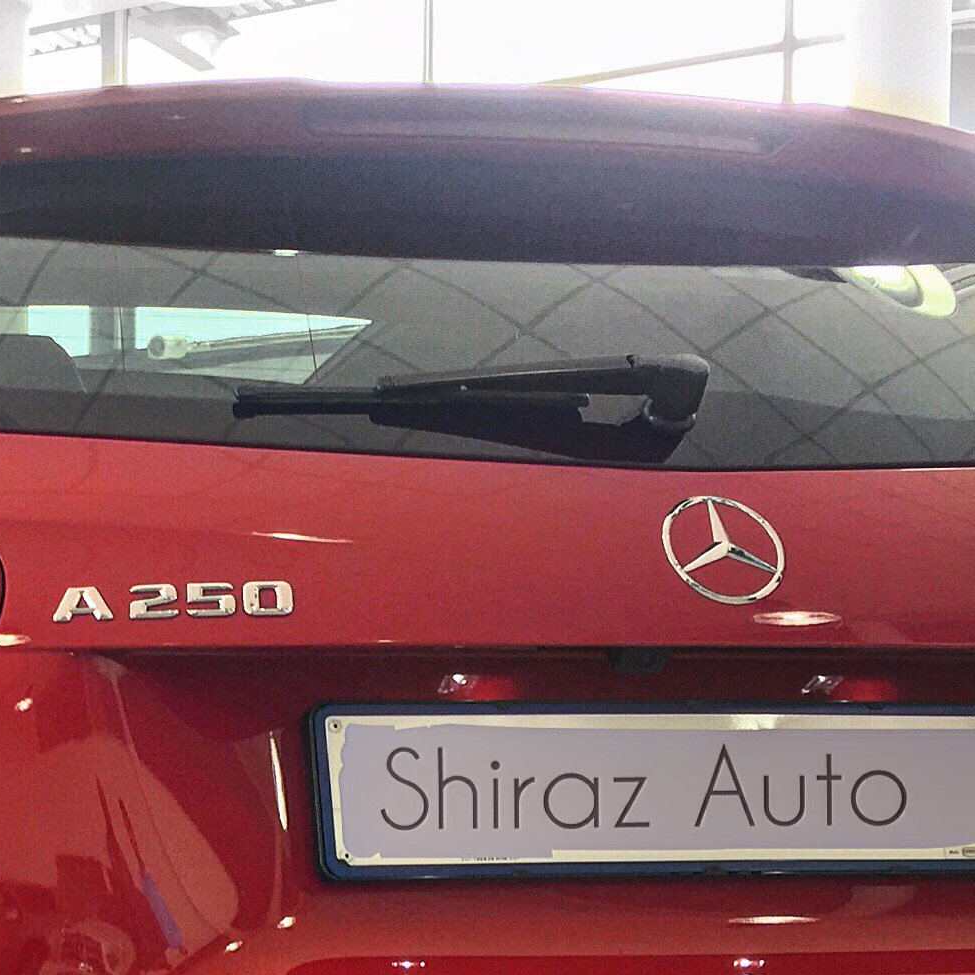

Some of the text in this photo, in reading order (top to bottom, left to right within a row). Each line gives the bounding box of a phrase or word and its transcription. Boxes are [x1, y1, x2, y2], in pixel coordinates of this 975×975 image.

[53, 580, 293, 622] A 250
[380, 744, 908, 830] Shiraz Auto
